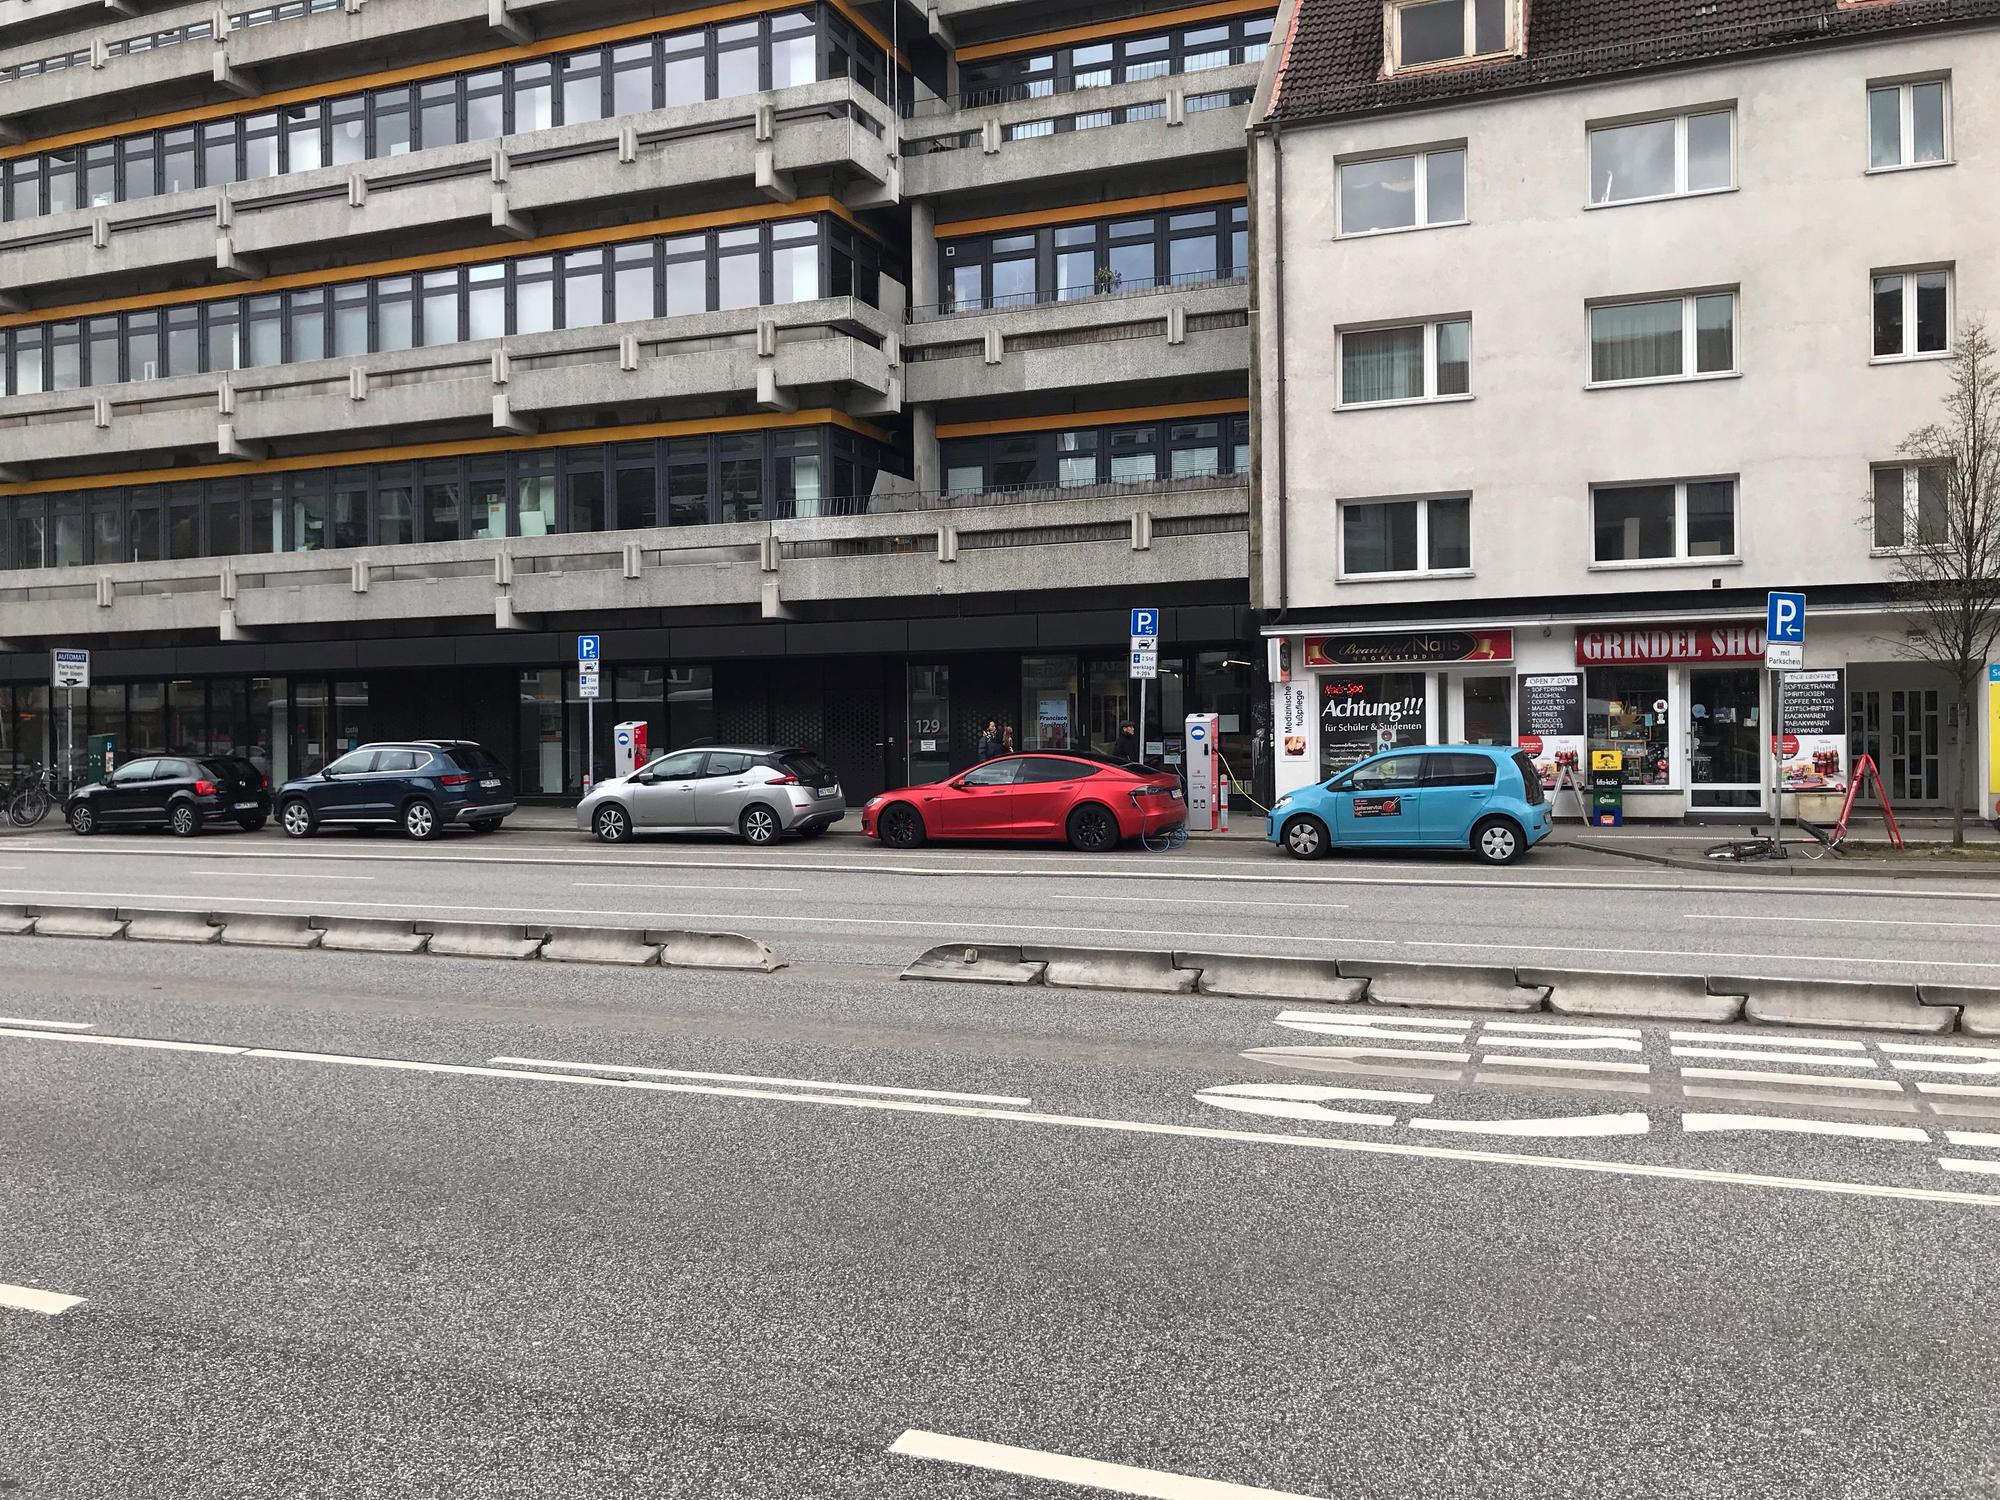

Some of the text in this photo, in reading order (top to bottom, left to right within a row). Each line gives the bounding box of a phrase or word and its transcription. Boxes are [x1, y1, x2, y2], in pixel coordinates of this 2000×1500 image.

[1137, 612, 1152, 633] P
[1776, 599, 1796, 635] P
[583, 639, 594, 657] P
[1339, 635, 1460, 657] Beautiful Nails
[1582, 627, 1767, 660] GRINDEL SHO
[57, 653, 86, 661] AUTOMAT
[1352, 653, 1444, 662] NAGELSTUDIO
[1768, 657, 1801, 666] Parkschein
[1529, 677, 1549, 685] OPEN
[1557, 676, 1576, 684] DAYS
[1321, 697, 1424, 722] Achtung!!!
[915, 719, 941, 733] 129
[1338, 723, 1369, 731] Schüler
[1370, 723, 1378, 731] &
[1379, 722, 1422, 731] Studenten
[107, 742, 113, 751] P
